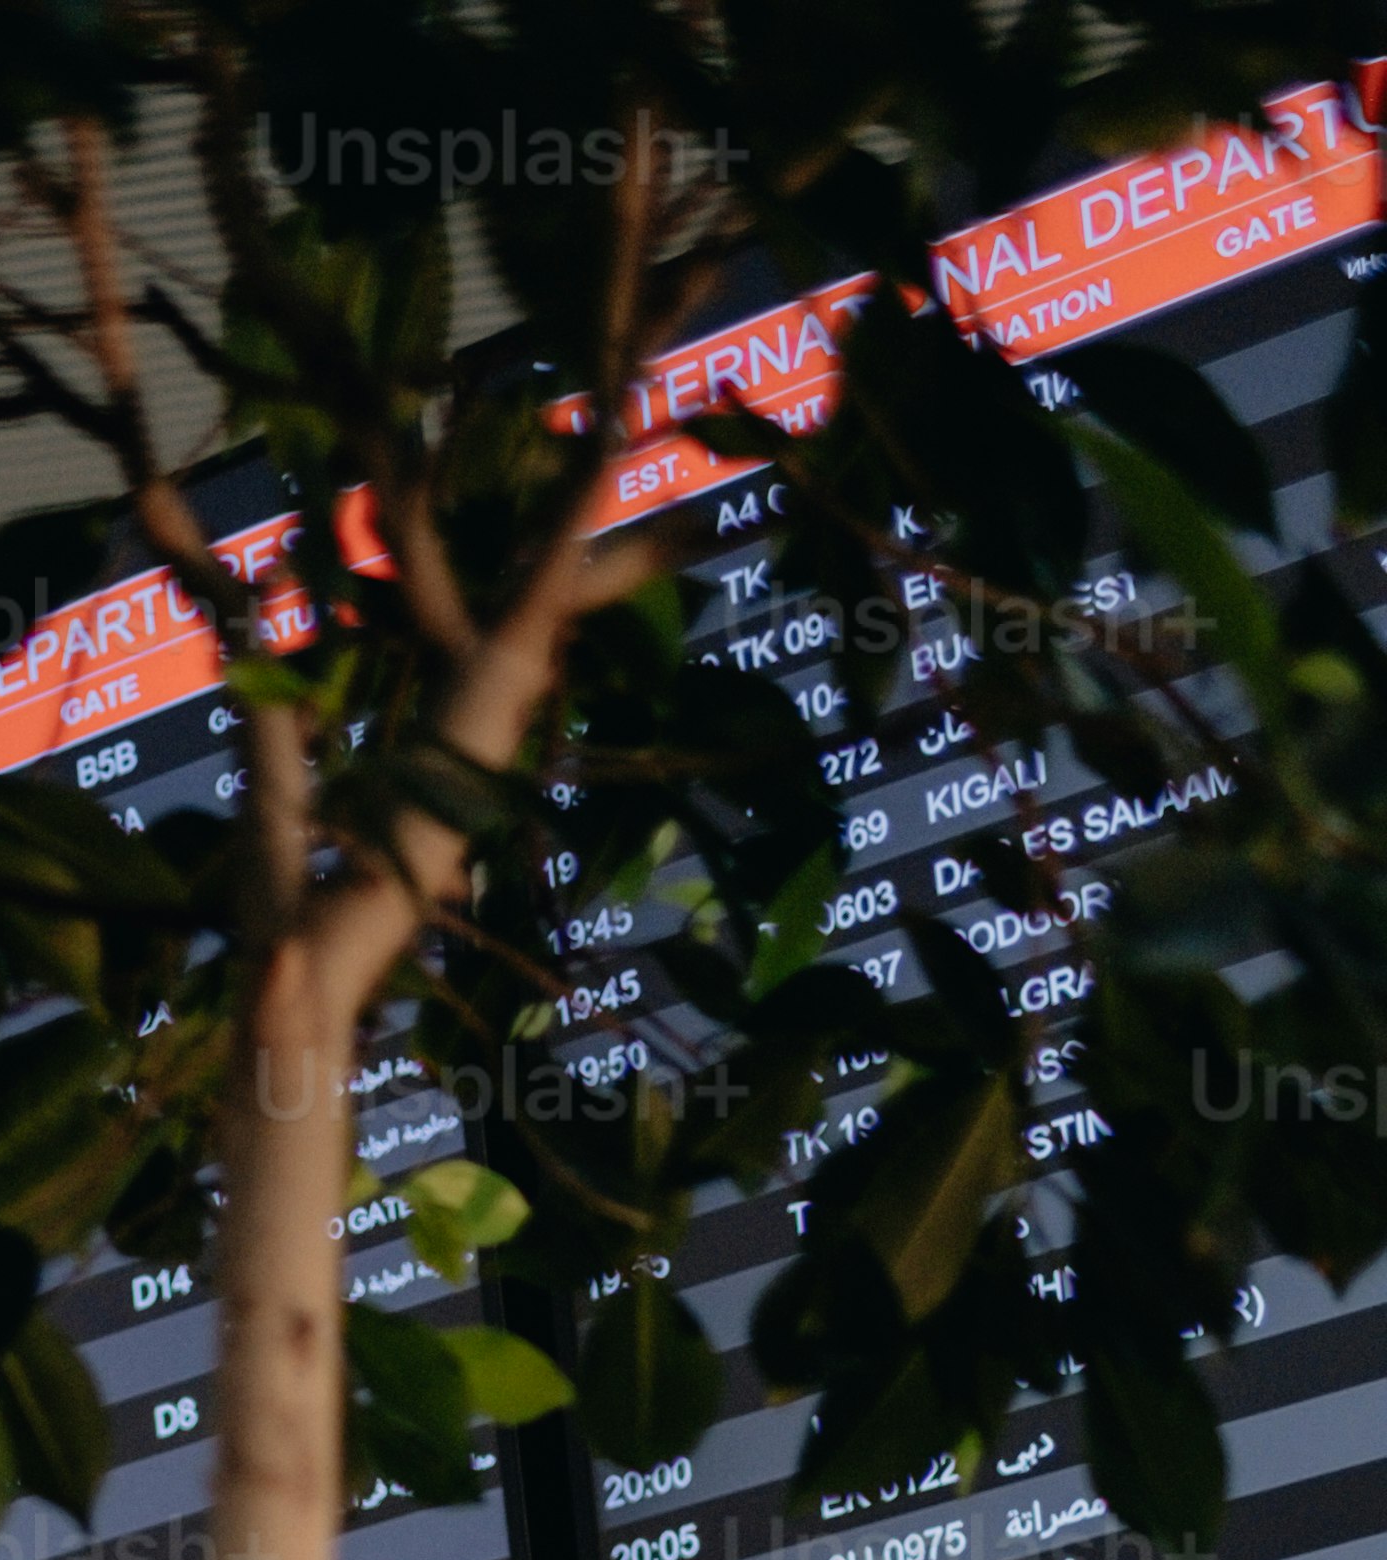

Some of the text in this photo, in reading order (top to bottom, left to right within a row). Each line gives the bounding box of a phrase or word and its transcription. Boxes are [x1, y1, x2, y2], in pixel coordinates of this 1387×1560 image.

[1215, 196, 1316, 257] GATE
[61, 673, 140, 725] GATE
[132, 1265, 193, 1310] D14
[154, 1397, 198, 1438] D8
[604, 1457, 693, 1509] 20:00
